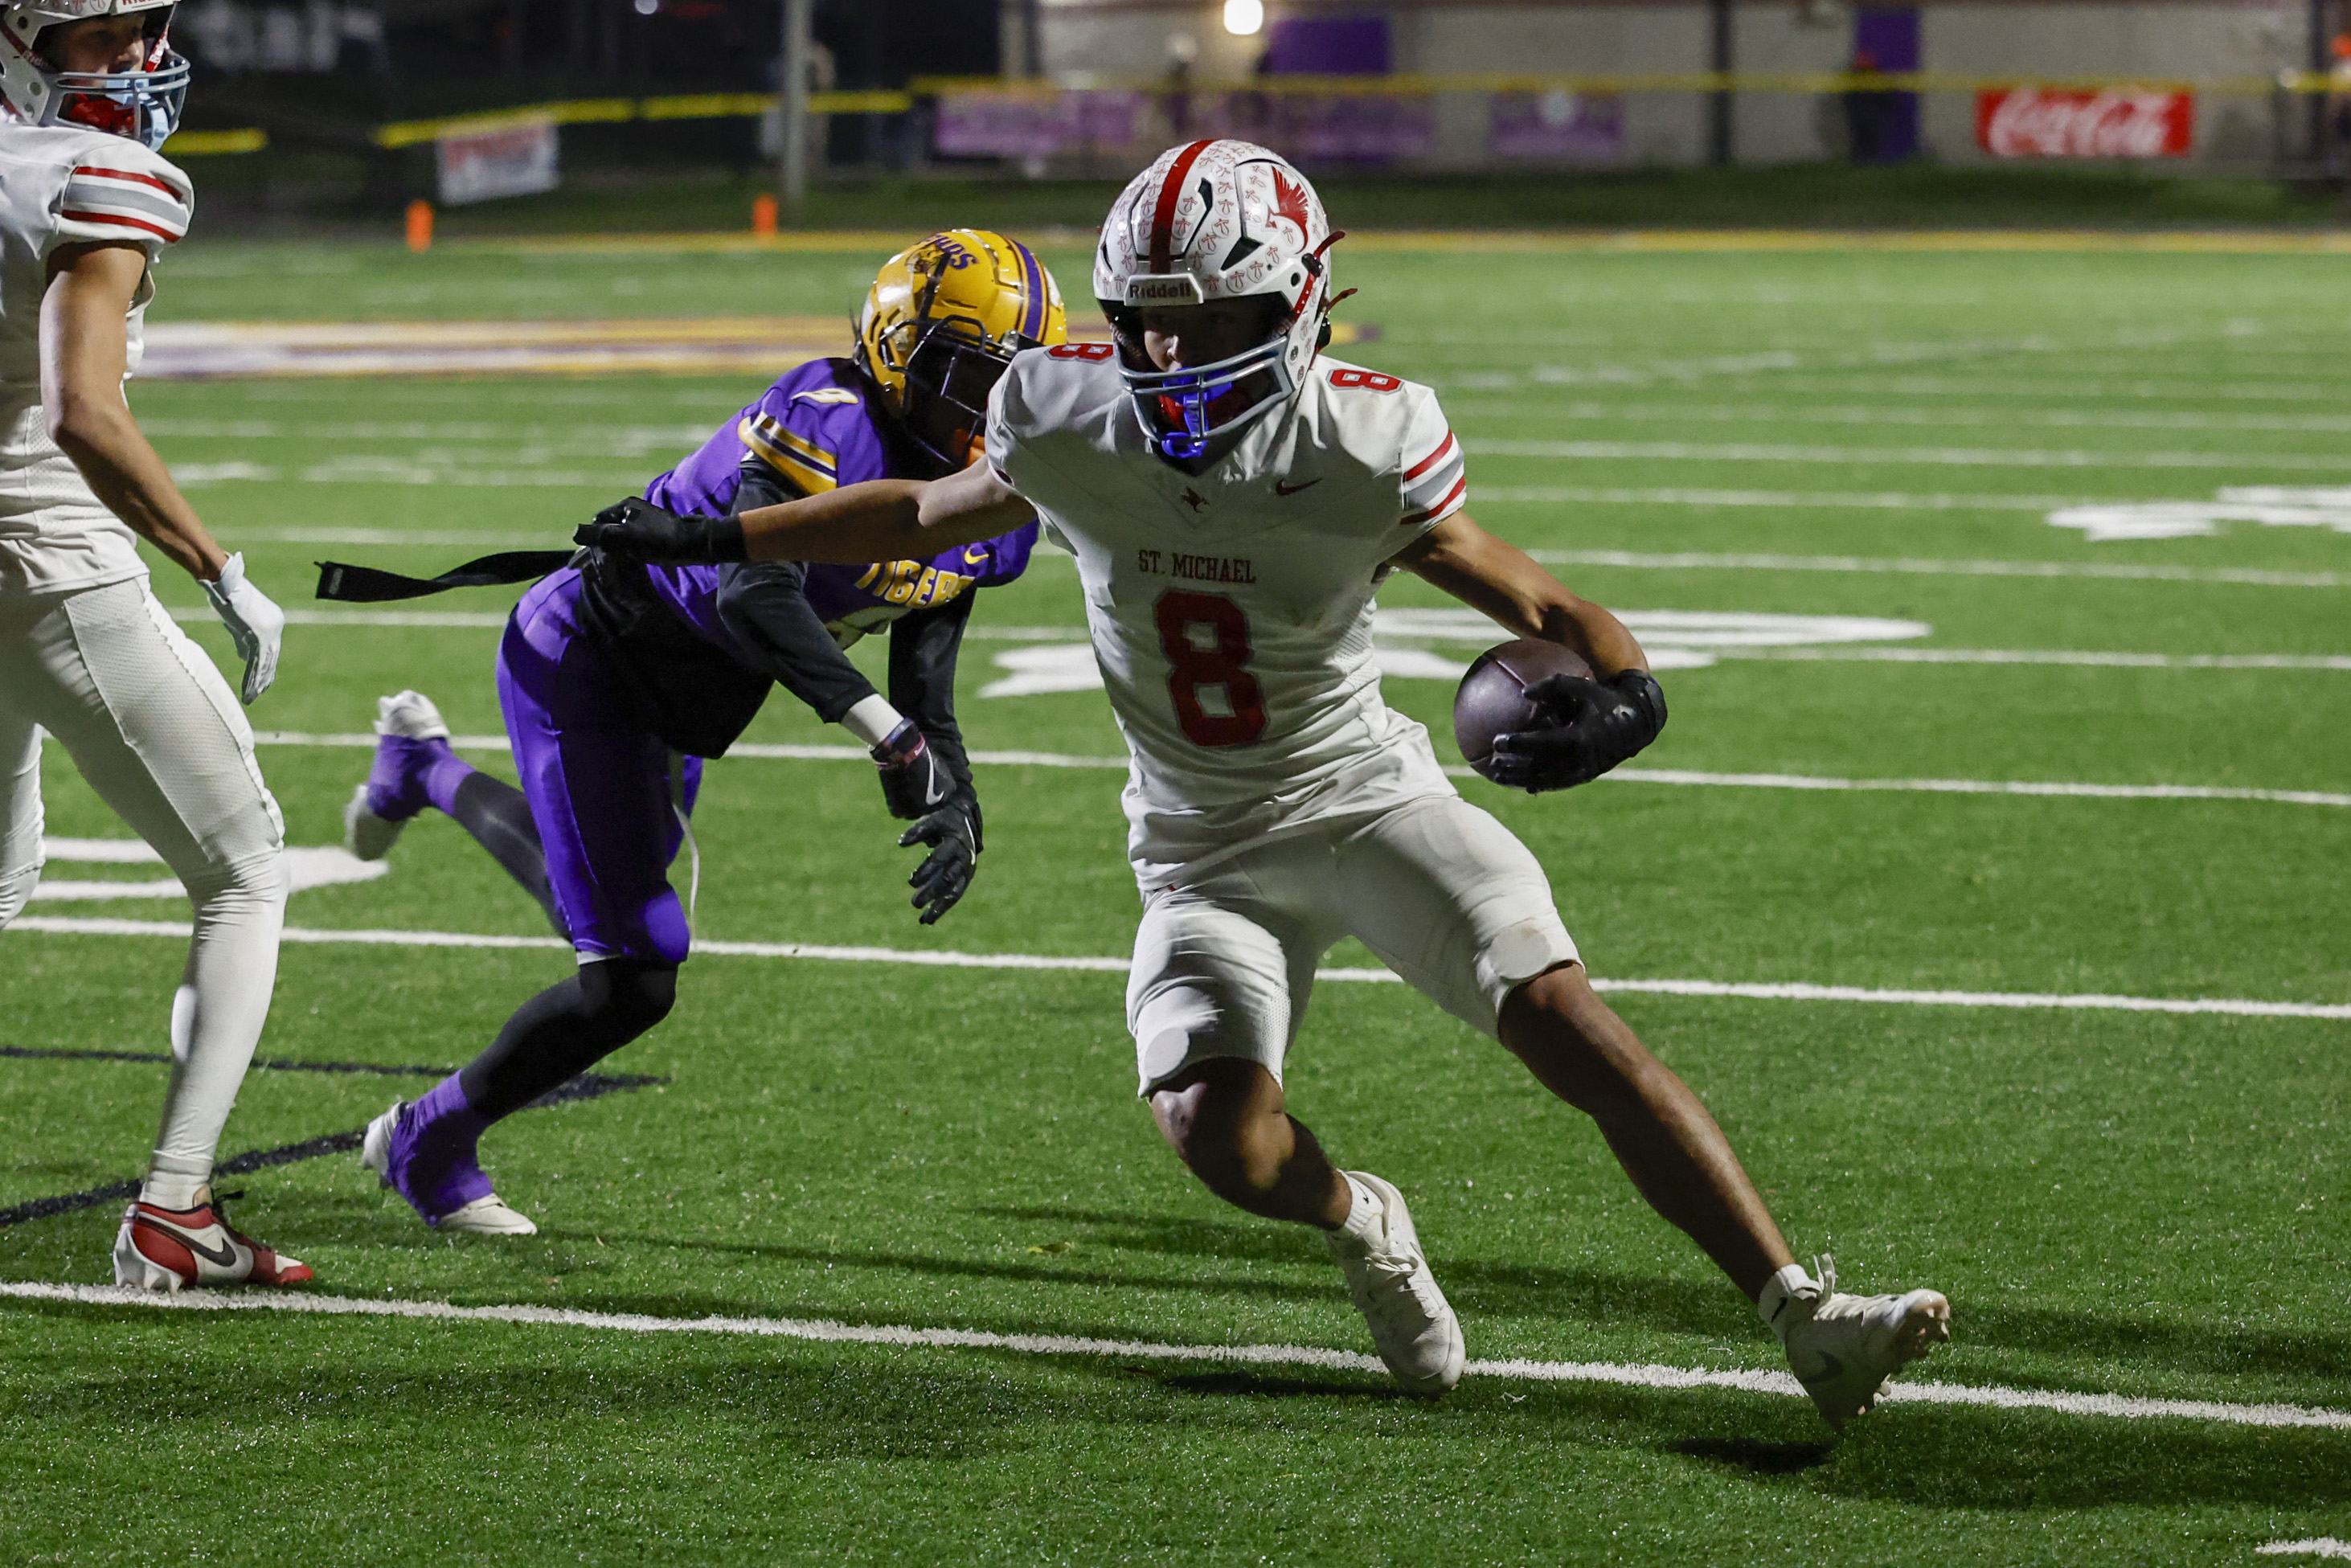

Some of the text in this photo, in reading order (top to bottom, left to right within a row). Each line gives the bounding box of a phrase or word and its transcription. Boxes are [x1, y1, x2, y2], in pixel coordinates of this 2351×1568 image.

[1129, 283, 1191, 298] Riddell
[1044, 343, 1114, 364] 8
[1326, 368, 1405, 395] 8
[1138, 550, 1257, 583] ST. MICHAEL
[1153, 587, 1271, 748] 8
